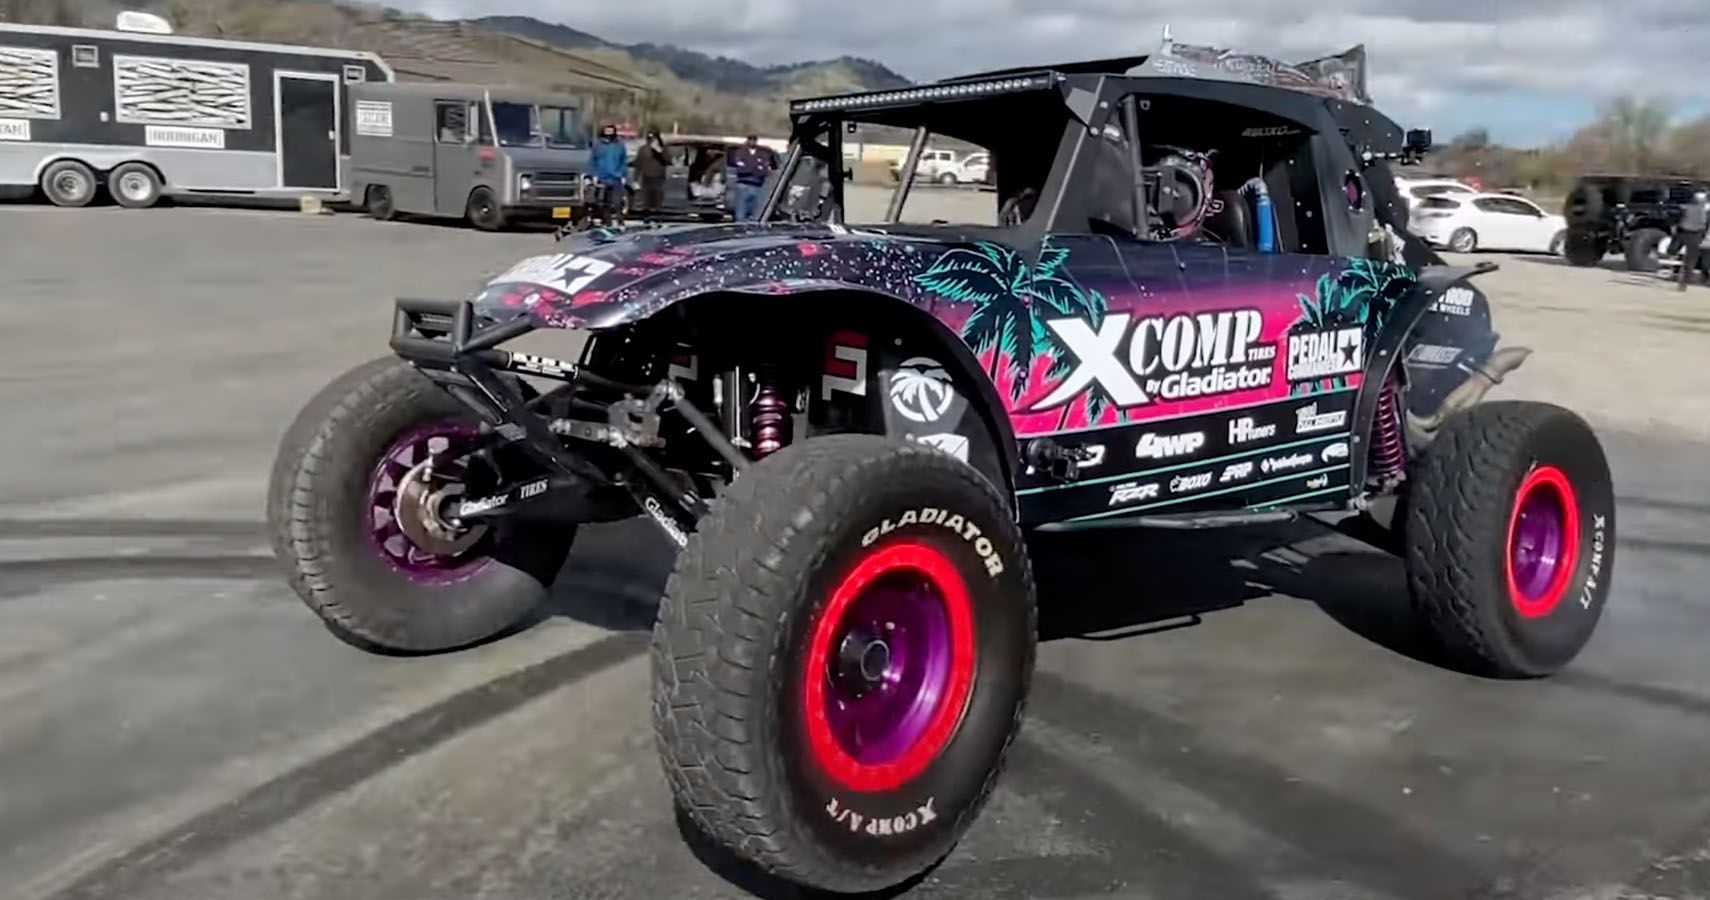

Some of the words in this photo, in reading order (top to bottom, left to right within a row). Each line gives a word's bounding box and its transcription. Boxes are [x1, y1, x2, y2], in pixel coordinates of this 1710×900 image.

[1248, 345, 1276, 361] TIRES
[1288, 331, 1338, 366] PEDAL
[520, 478, 549, 499] TIRES
[861, 507, 1004, 577] GLADIATOR
[826, 797, 864, 832] A/T
